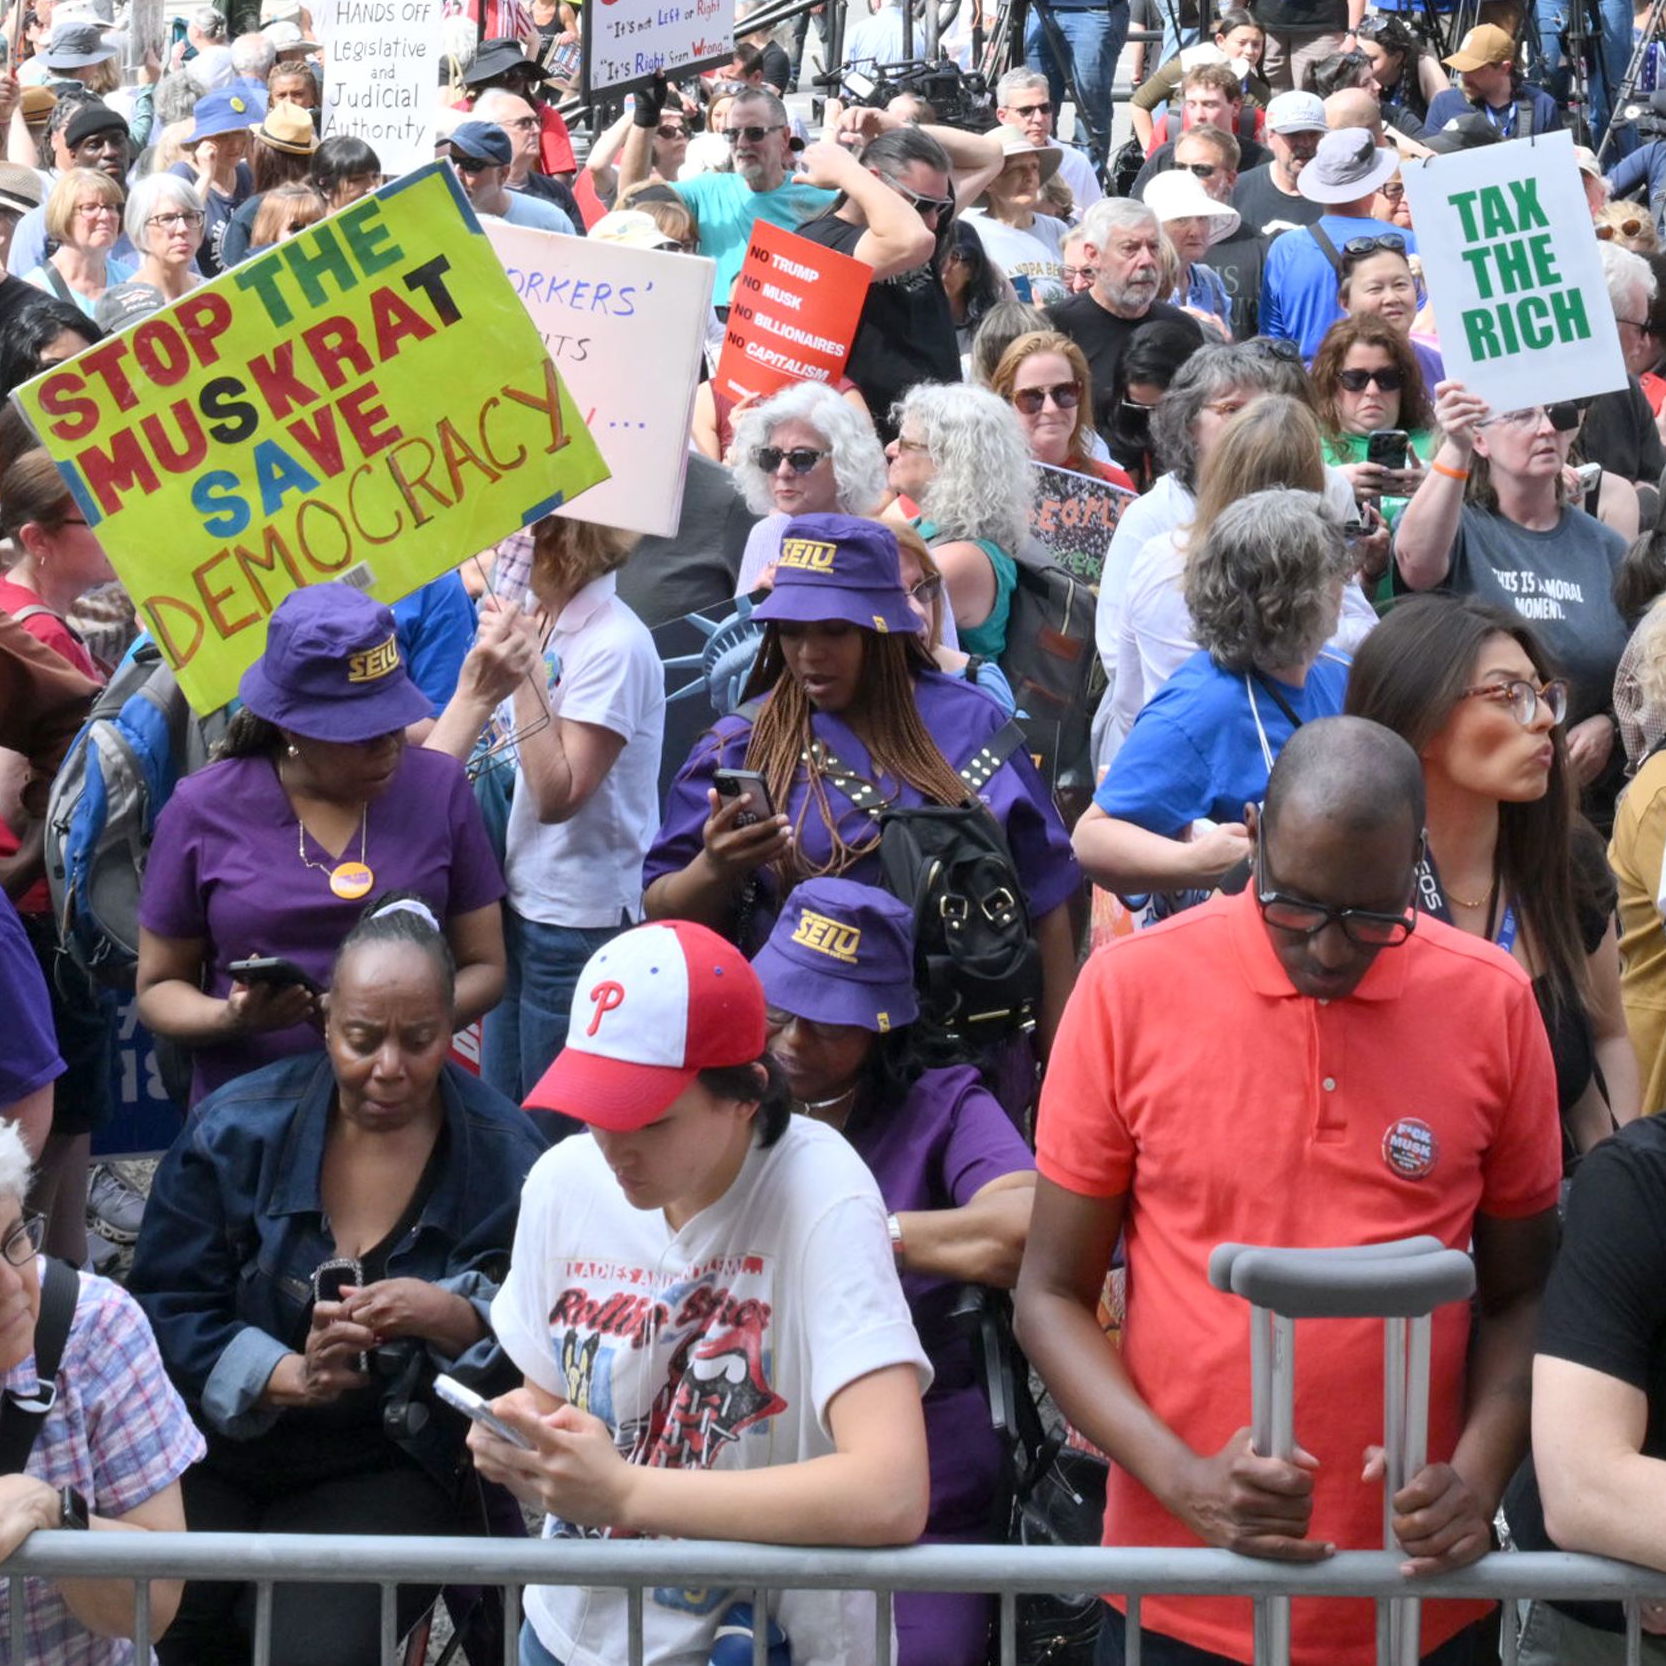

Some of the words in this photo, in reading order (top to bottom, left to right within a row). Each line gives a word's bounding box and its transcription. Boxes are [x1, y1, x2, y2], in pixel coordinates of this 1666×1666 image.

[336, 0, 395, 25] HANDS
[401, 3, 431, 23] OFF
[334, 36, 426, 61] Legislative
[371, 64, 395, 79] and
[331, 82, 419, 108] Judicial
[324, 114, 426, 147] Authority
[1447, 177, 1550, 243] TAX
[750, 246, 769, 263] NO
[772, 253, 819, 283] TRUMP
[1461, 233, 1563, 300] THE
[507, 269, 654, 316] ORKERS'
[742, 274, 761, 291] NO
[762, 283, 803, 310] MUSK
[38, 292, 232, 441] STOP
[236, 200, 406, 329] THE
[734, 303, 753, 320] NO
[753, 312, 845, 357] BILLIONAIRES
[1461, 287, 1592, 362] RICH
[727, 332, 745, 349] NO
[746, 342, 830, 381] CAPITALISM
[74, 254, 463, 517] MUSKRAT
[191, 380, 403, 537] SAVE
[143, 358, 571, 672] DEMOCRACY
[781, 541, 836, 568] SEIU
[1521, 571, 1534, 592] IS
[1545, 579, 1583, 603] MORAL
[349, 639, 397, 677] SEIU
[796, 915, 860, 955] SEIU
[587, 980, 625, 1037] P
[1389, 1135, 1432, 1158] MUSK
